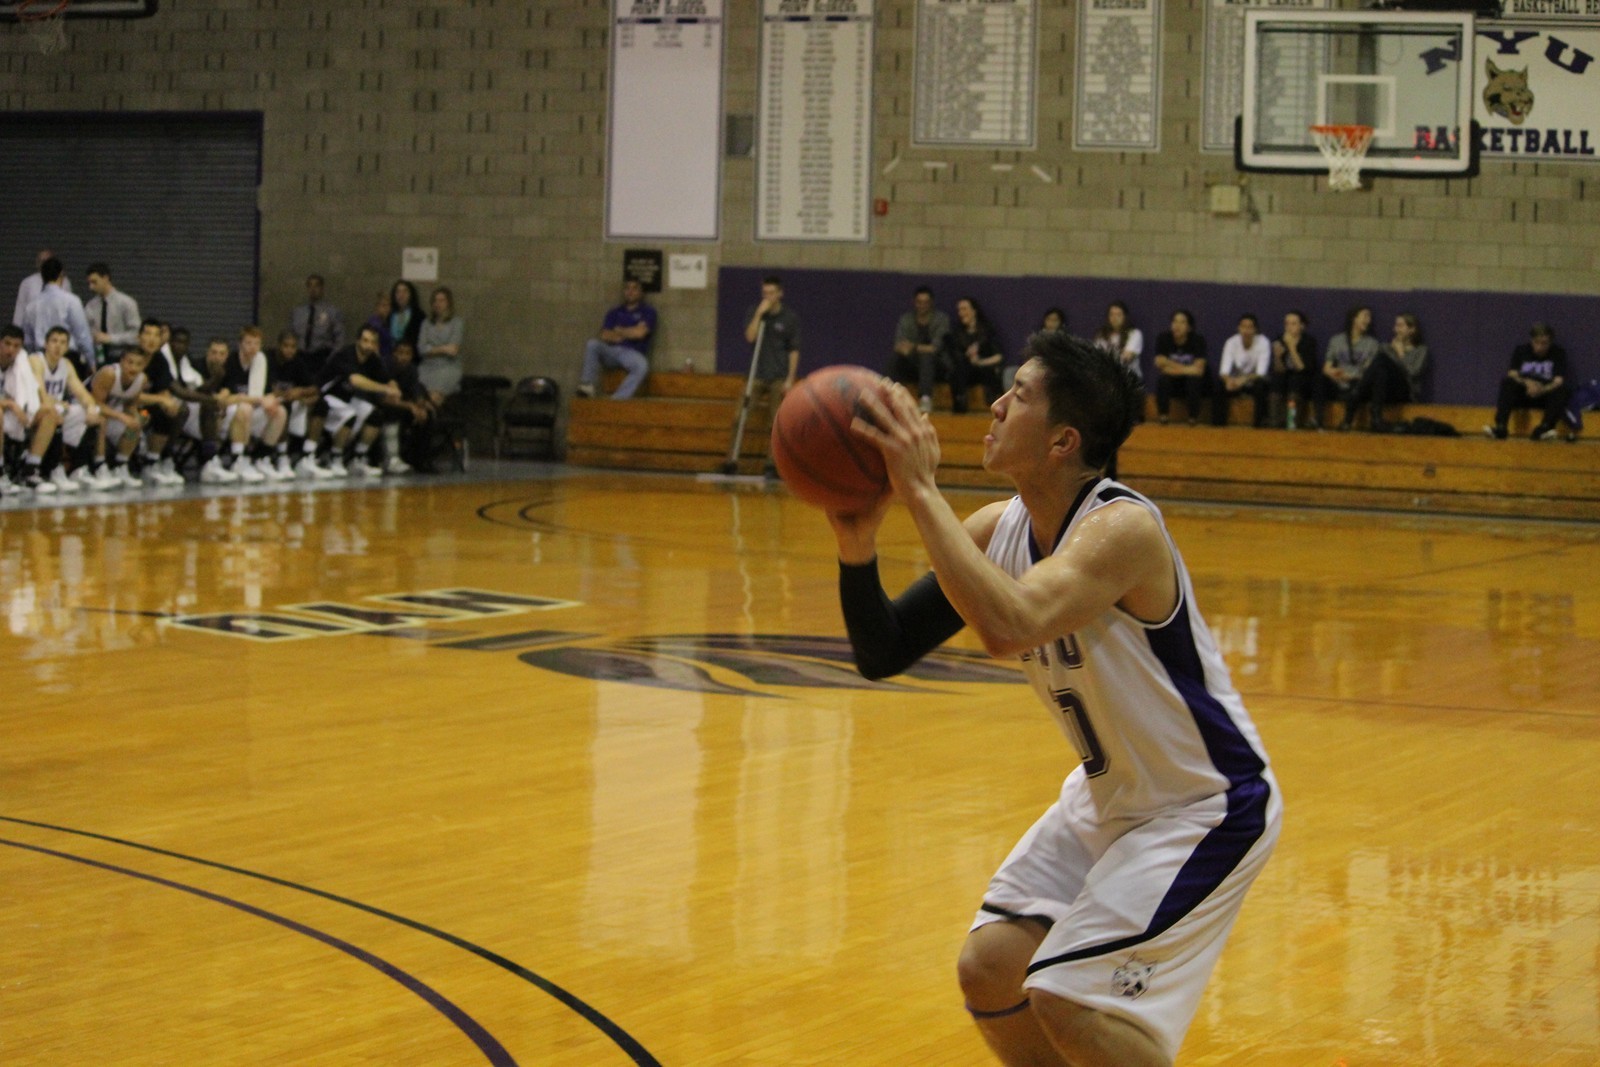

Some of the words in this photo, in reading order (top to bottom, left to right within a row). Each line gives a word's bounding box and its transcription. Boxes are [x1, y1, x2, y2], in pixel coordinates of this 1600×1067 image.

[1513, 0, 1580, 14] BASKETBALL
[1419, 31, 1595, 75] NYU
[1415, 125, 1595, 155] BAKETBALL
